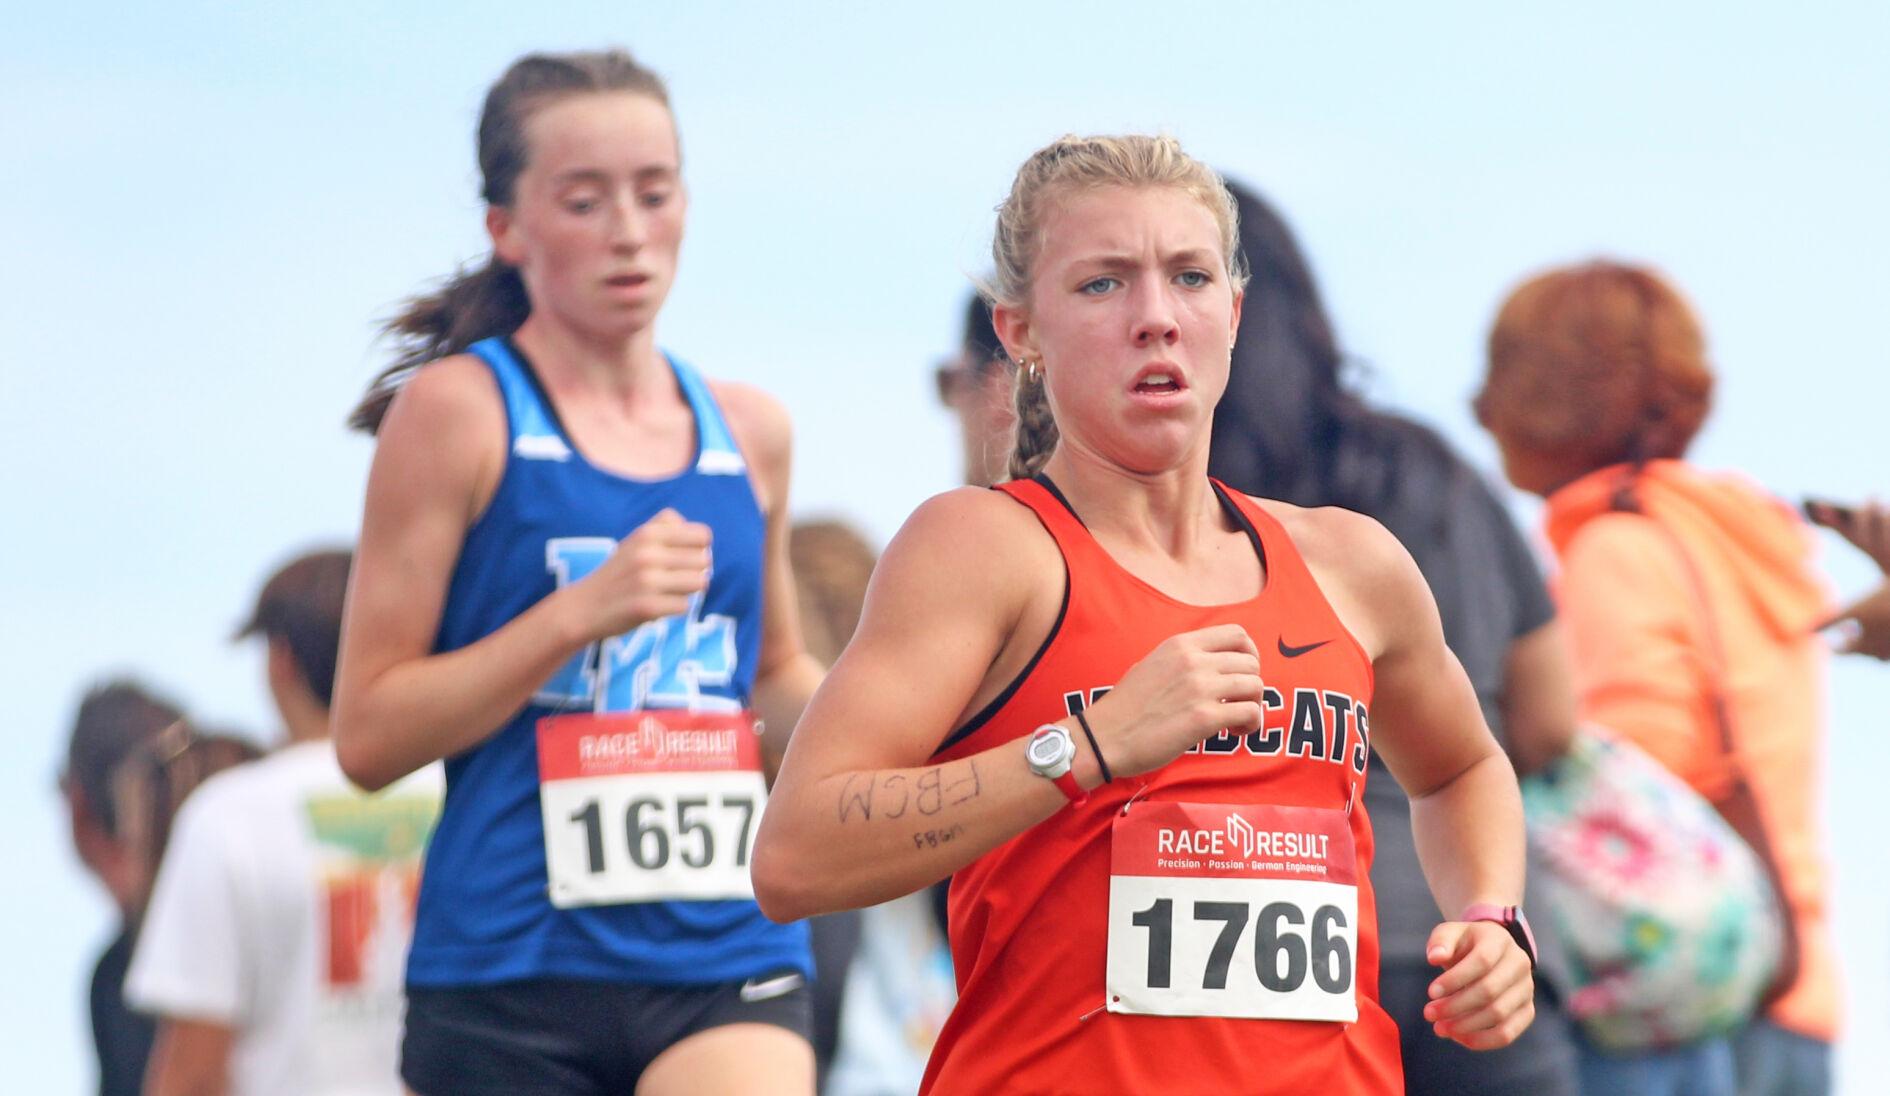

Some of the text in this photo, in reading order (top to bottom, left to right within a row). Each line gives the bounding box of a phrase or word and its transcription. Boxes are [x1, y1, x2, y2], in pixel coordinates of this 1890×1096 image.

[578, 733, 640, 759] RACE
[569, 794, 755, 875] 1657
[1157, 829, 1329, 859] RACE RESULT
[1157, 858, 1328, 875] Precision Passion German Engineering
[1132, 898, 1352, 995] 1766
